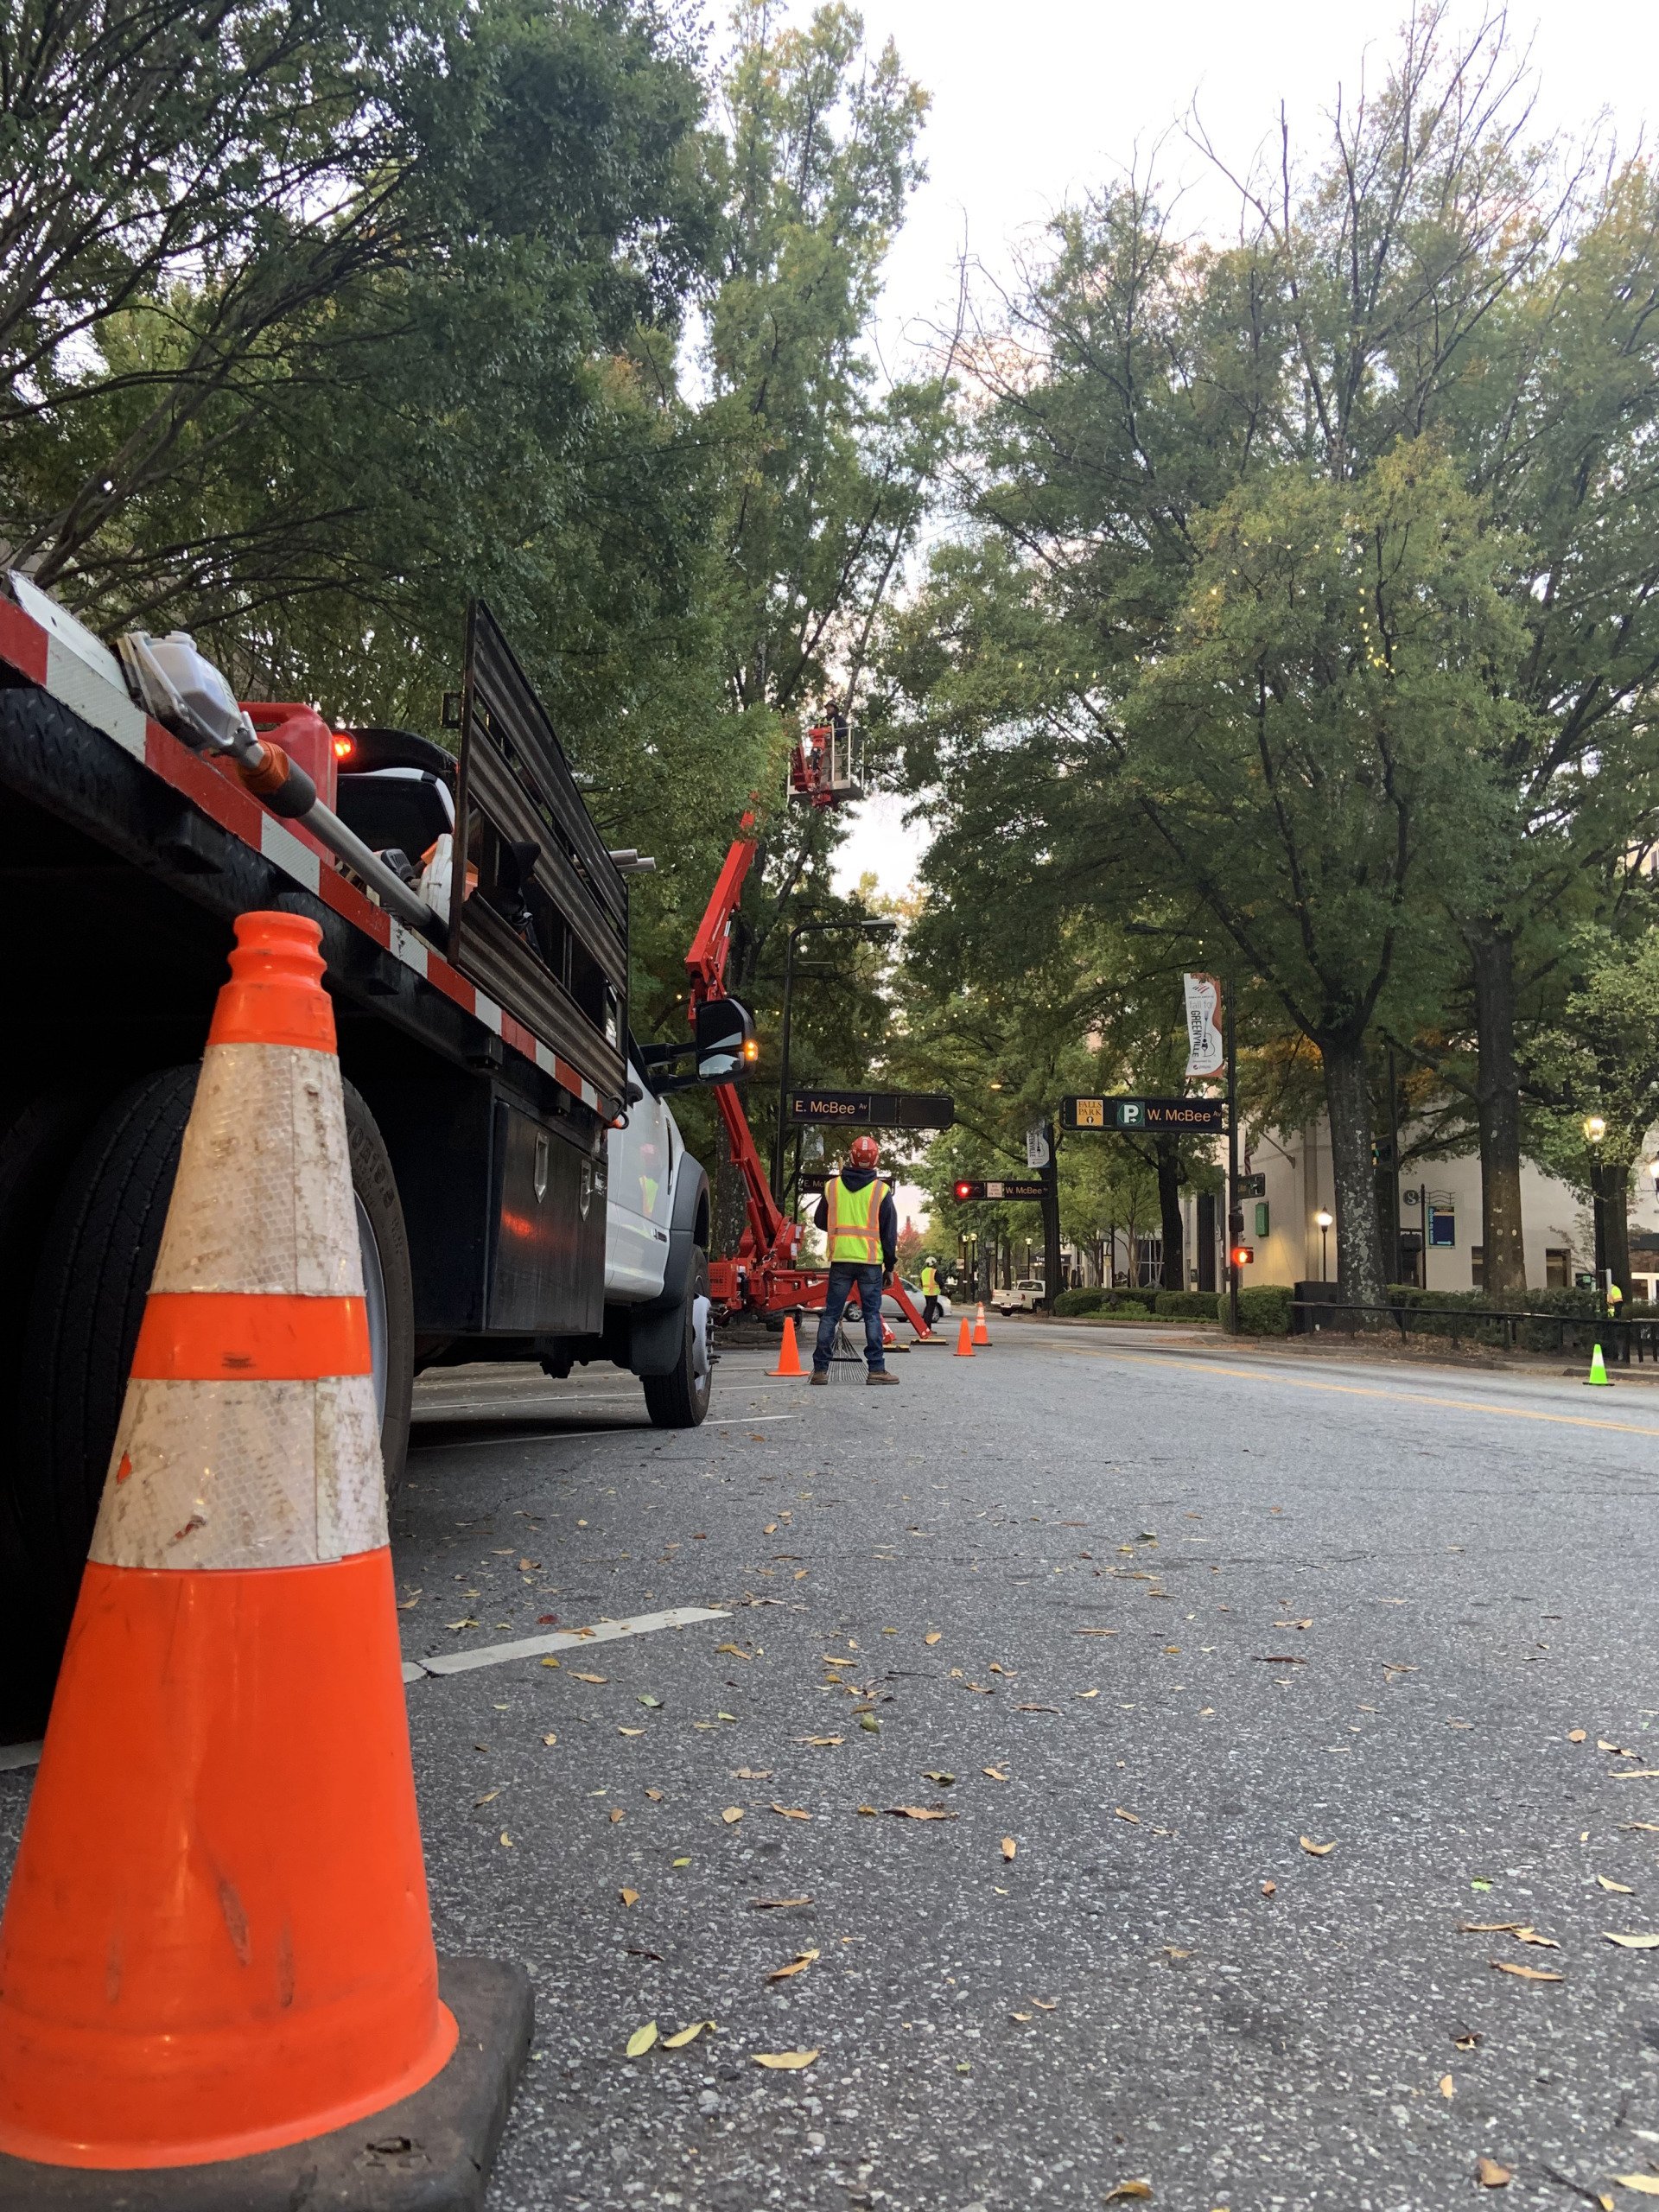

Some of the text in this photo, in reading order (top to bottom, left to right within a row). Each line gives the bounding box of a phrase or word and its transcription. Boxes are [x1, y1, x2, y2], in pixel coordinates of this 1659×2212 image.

[1191, 1010, 1202, 1058] GREENVILLE
[795, 1100, 807, 1112] E.
[810, 1101, 855, 1115] McBee
[1123, 1104, 1139, 1123] P
[1147, 1109, 1162, 1121] W.
[1166, 1109, 1211, 1122] McBee
[1015, 1186, 1042, 1195] McBee
